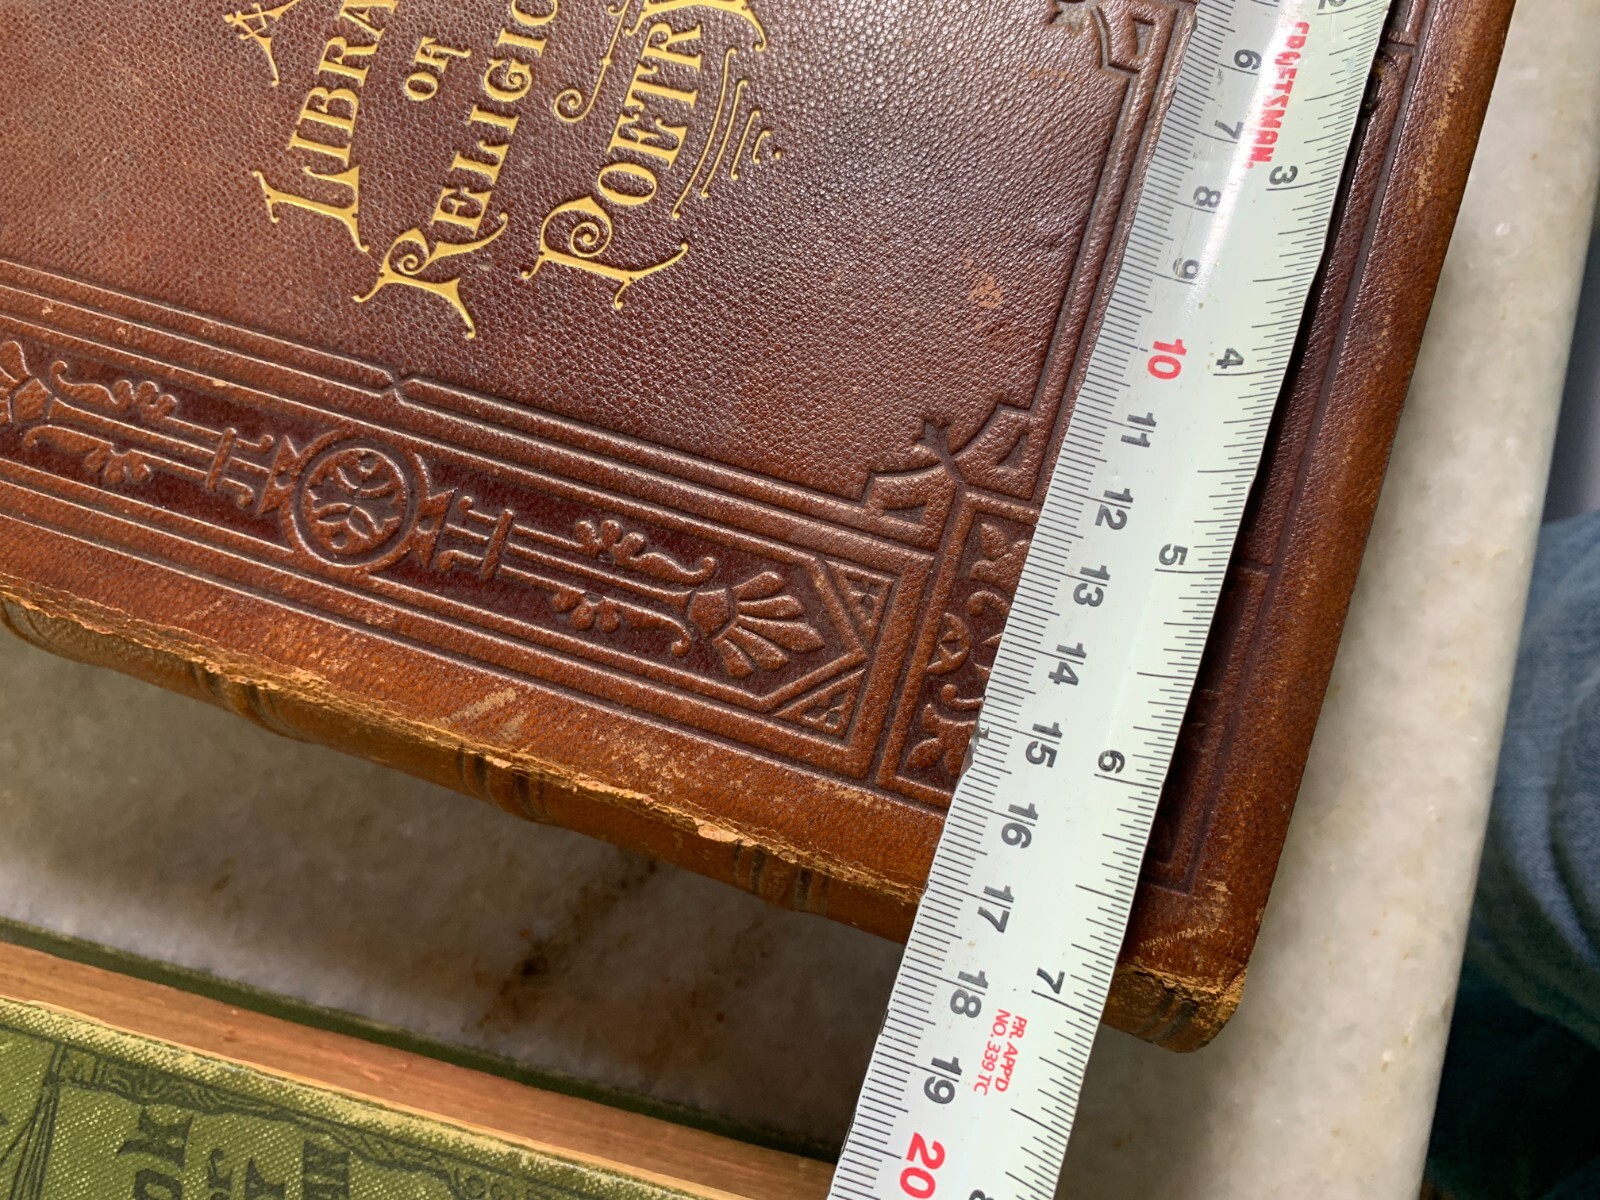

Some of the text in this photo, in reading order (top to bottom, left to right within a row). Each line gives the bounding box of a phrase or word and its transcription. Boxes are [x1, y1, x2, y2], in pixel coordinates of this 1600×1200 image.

[405, 36, 472, 101] OF
[1233, 49, 1263, 71] 6
[1214, 119, 1244, 140] 7
[1192, 185, 1222, 208] 8
[1269, 165, 1299, 185] 3
[1172, 257, 1200, 279] 9
[1147, 338, 1187, 380] 10
[1216, 347, 1245, 370] 4
[1120, 412, 1157, 448] 11
[1094, 487, 1134, 530] 12
[1158, 543, 1189, 566] 5
[1073, 564, 1110, 608] 13
[1048, 642, 1087, 686] 14
[1025, 721, 1063, 768] 15
[1098, 749, 1126, 774] 6
[1001, 802, 1039, 849] 16
[977, 884, 1015, 934] 17
[950, 970, 989, 1019] 18
[1036, 967, 1066, 995] 7
[973, 1008, 1011, 1096] NO. 339 TC
[995, 1041, 1019, 1092] APP'D
[923, 1056, 963, 1105] 19
[899, 1132, 946, 1200] 20
